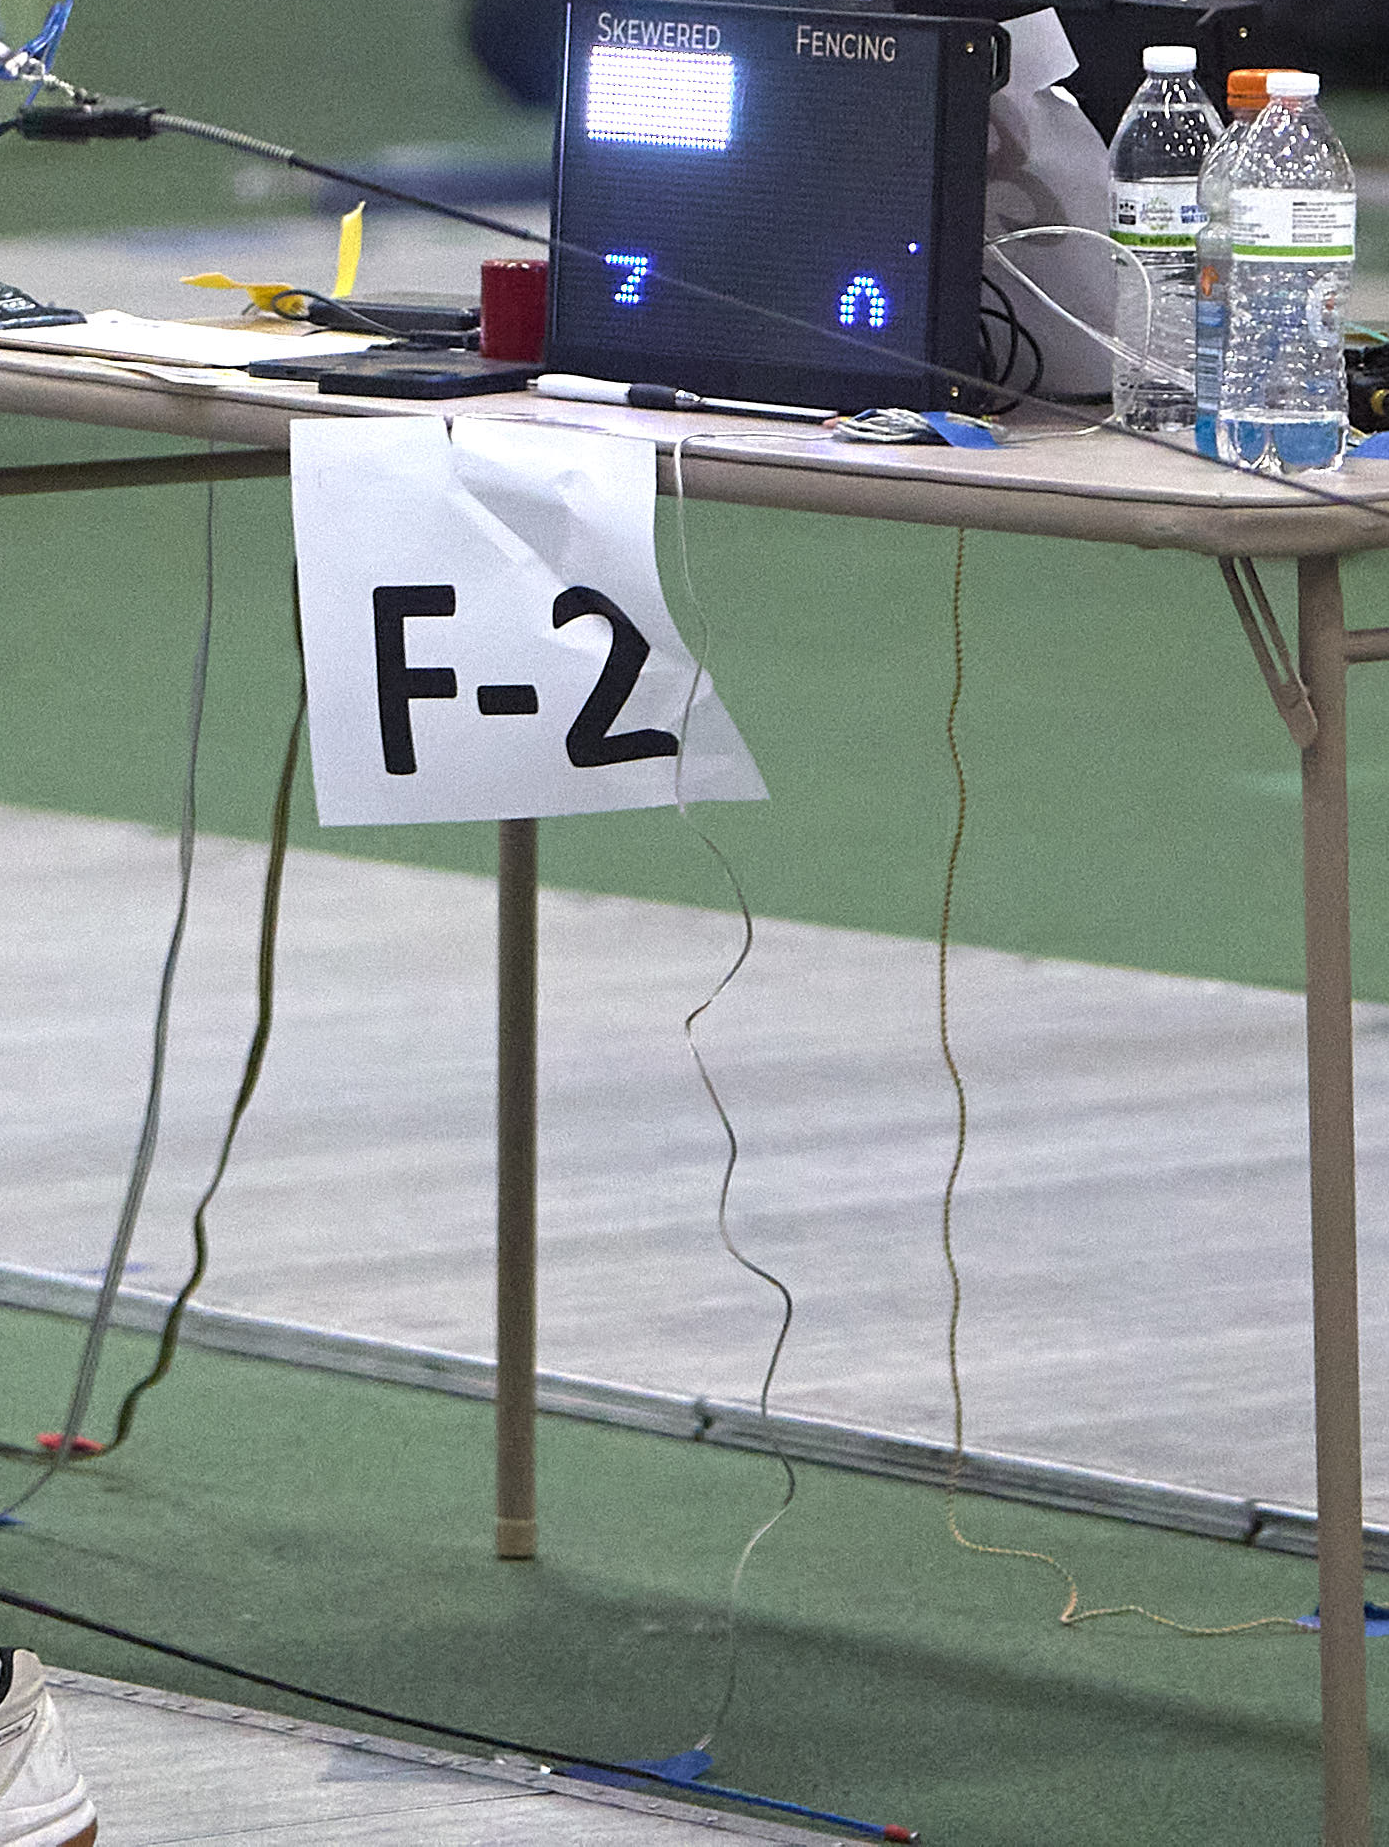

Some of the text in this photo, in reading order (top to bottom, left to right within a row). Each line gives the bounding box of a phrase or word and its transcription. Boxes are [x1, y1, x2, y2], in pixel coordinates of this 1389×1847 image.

[597, 12, 897, 63] SKEWERED FENCING
[373, 584, 679, 775] F-2
